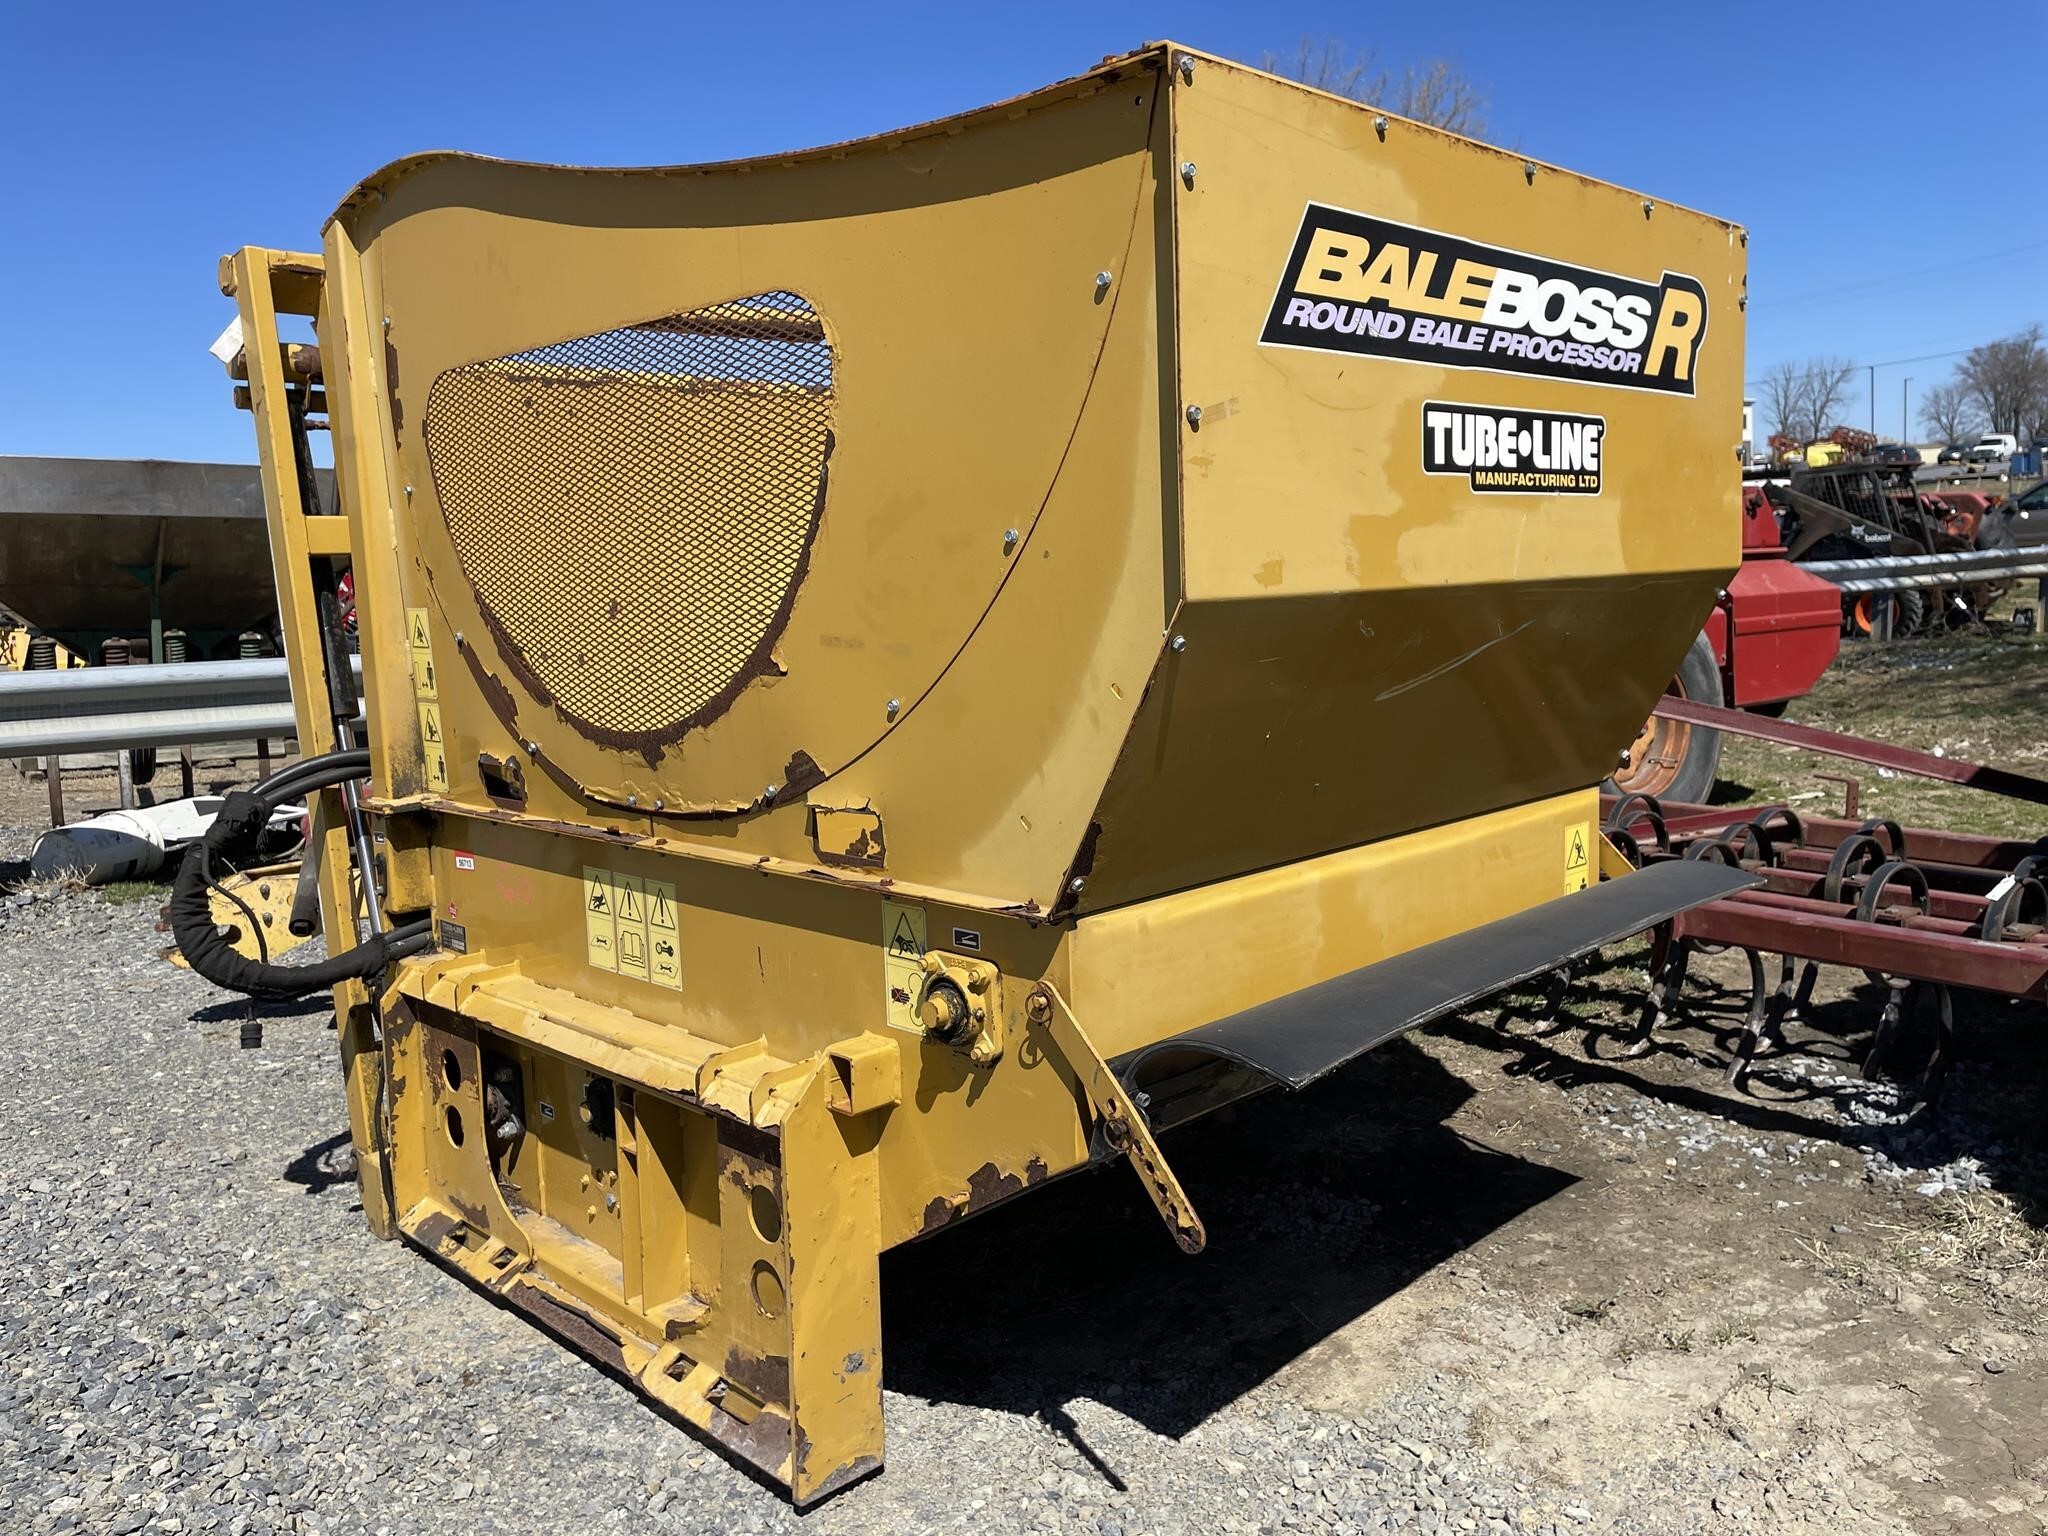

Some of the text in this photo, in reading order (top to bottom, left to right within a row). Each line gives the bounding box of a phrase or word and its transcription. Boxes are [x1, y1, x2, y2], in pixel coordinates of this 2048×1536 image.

[1282, 297, 1642, 374] ROUND BALE PROCESSOR
[1643, 287, 1703, 381] R
[1475, 471, 1598, 488] MANUFACTURING LTD
